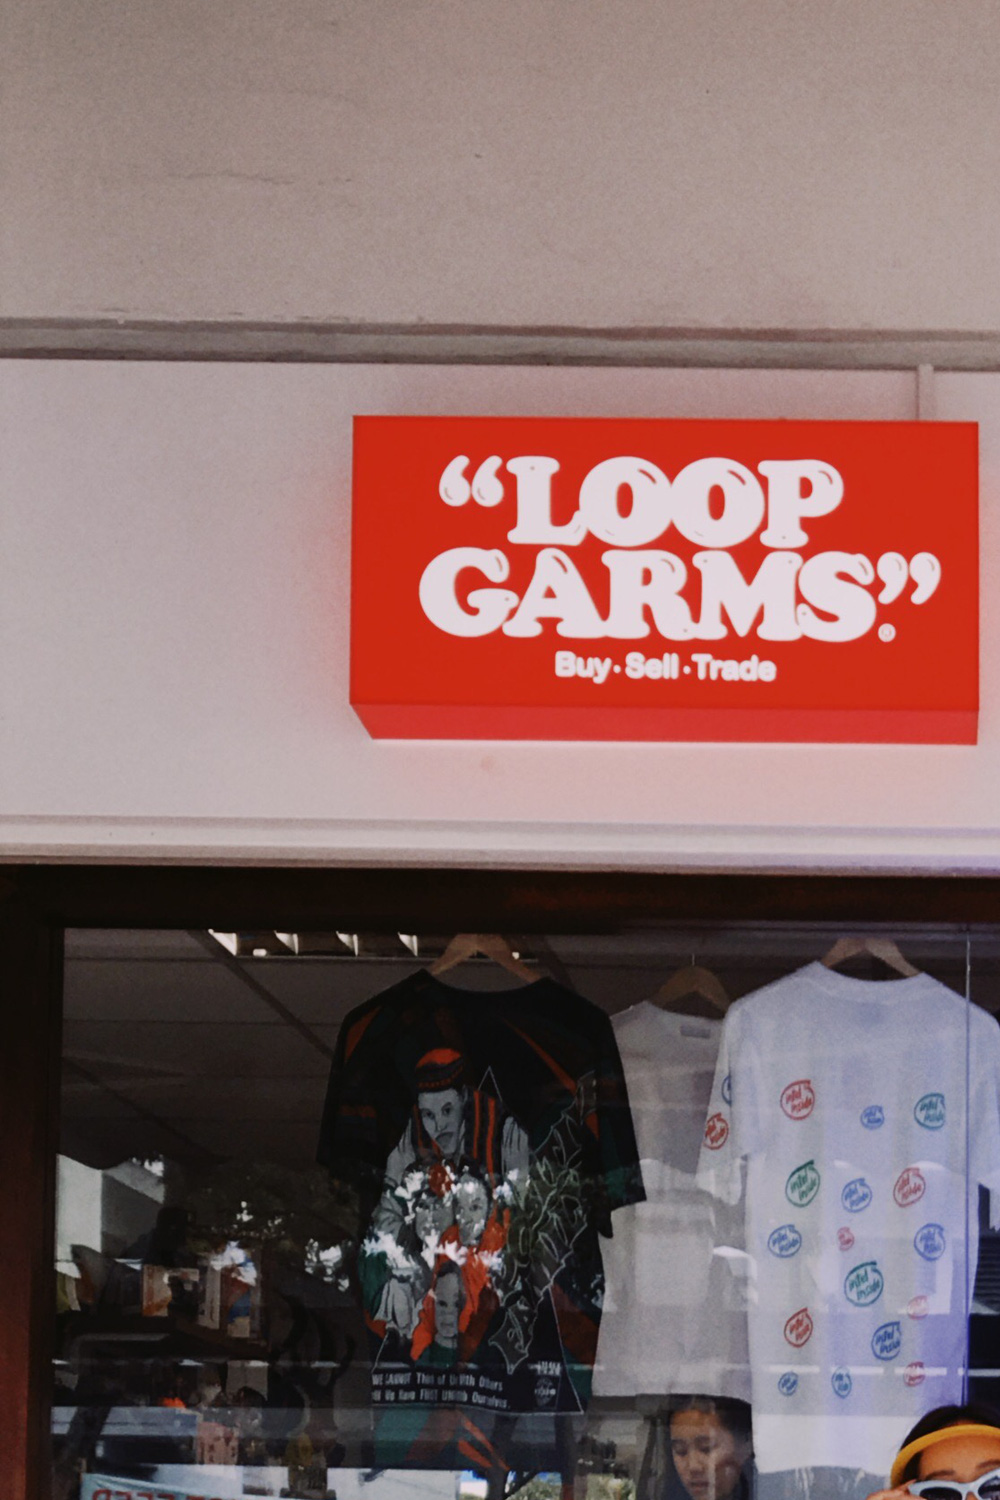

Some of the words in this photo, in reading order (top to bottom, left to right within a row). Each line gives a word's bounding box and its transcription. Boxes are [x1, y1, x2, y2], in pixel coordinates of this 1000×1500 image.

[555, 650, 612, 684] Buy
[624, 652, 679, 680] Sell
[691, 653, 777, 682] Trade
